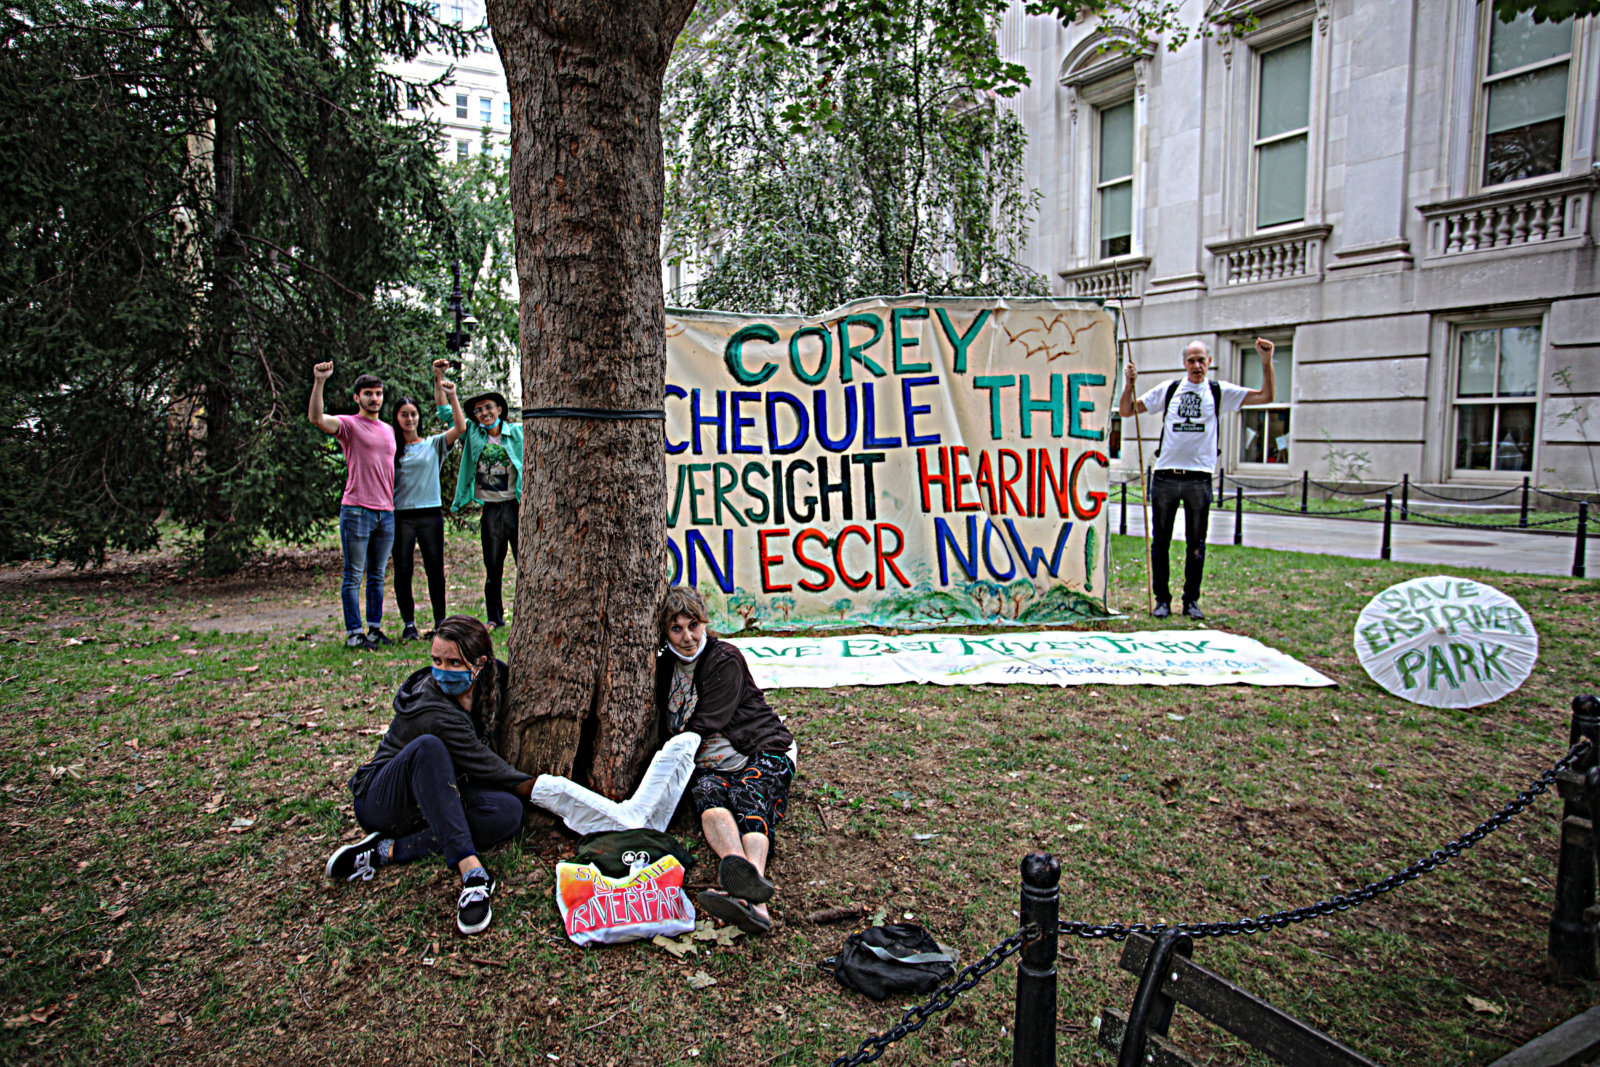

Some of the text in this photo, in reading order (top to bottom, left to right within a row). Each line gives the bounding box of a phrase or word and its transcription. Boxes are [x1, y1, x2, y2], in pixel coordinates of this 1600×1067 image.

[724, 306, 992, 387] COREY
[665, 373, 1107, 455] CHEDULE THE
[666, 445, 1110, 528] VERSIGHT HEARING
[757, 522, 912, 593] ESCR
[1379, 580, 1481, 614] SAVE
[738, 645, 822, 658] AVE
[836, 639, 944, 658] EAST
[1360, 604, 1530, 655] EAST RIVER
[1393, 642, 1513, 691] PARK
[572, 892, 643, 933] RIVER
